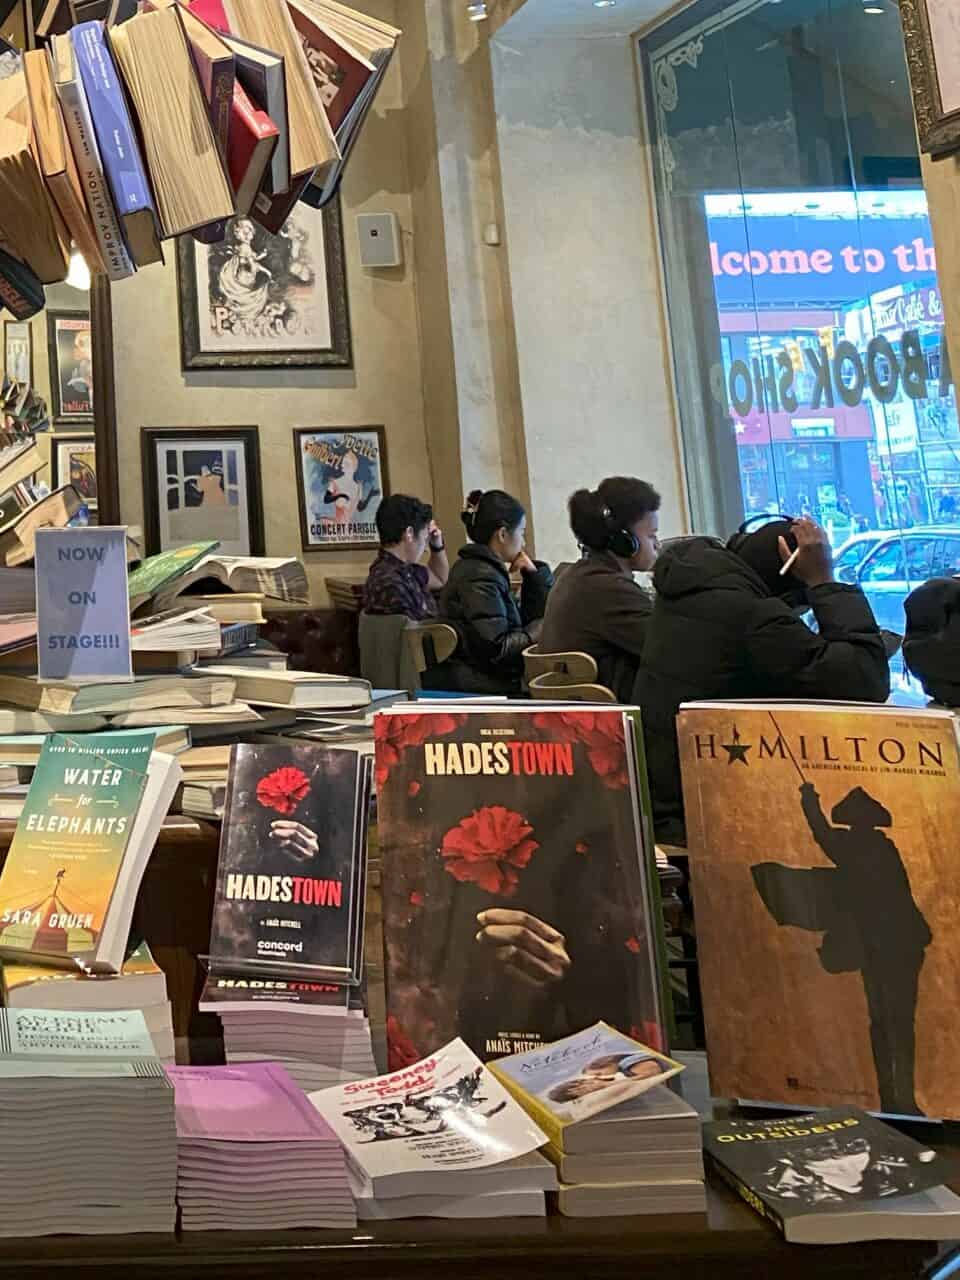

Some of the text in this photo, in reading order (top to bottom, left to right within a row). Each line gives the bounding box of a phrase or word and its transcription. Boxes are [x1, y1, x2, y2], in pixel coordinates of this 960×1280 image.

[86, 170, 122, 272] IMPROV NATION
[840, 245, 886, 273] to
[310, 523, 346, 536] CONCERT
[57, 547, 106, 561] NOW
[67, 591, 97, 605] ON
[47, 634, 120, 649] STAGE!!!
[424, 741, 574, 776] HADESTOWN
[63, 767, 122, 786] WATER
[76, 794, 92, 809] for
[26, 814, 128, 835] ELEPHANTS
[225, 873, 343, 908] HADESTOWN
[1, 909, 94, 929] SARA GRUEN
[257, 940, 303, 953] concord
[217, 979, 339, 993] HADESTOWN
[486, 1037, 512, 1054] ANAÏS
[343, 1058, 440, 1096] Sweeney
[369, 1076, 433, 1098] Todd
[716, 1117, 860, 1144] OUTSIDERS
